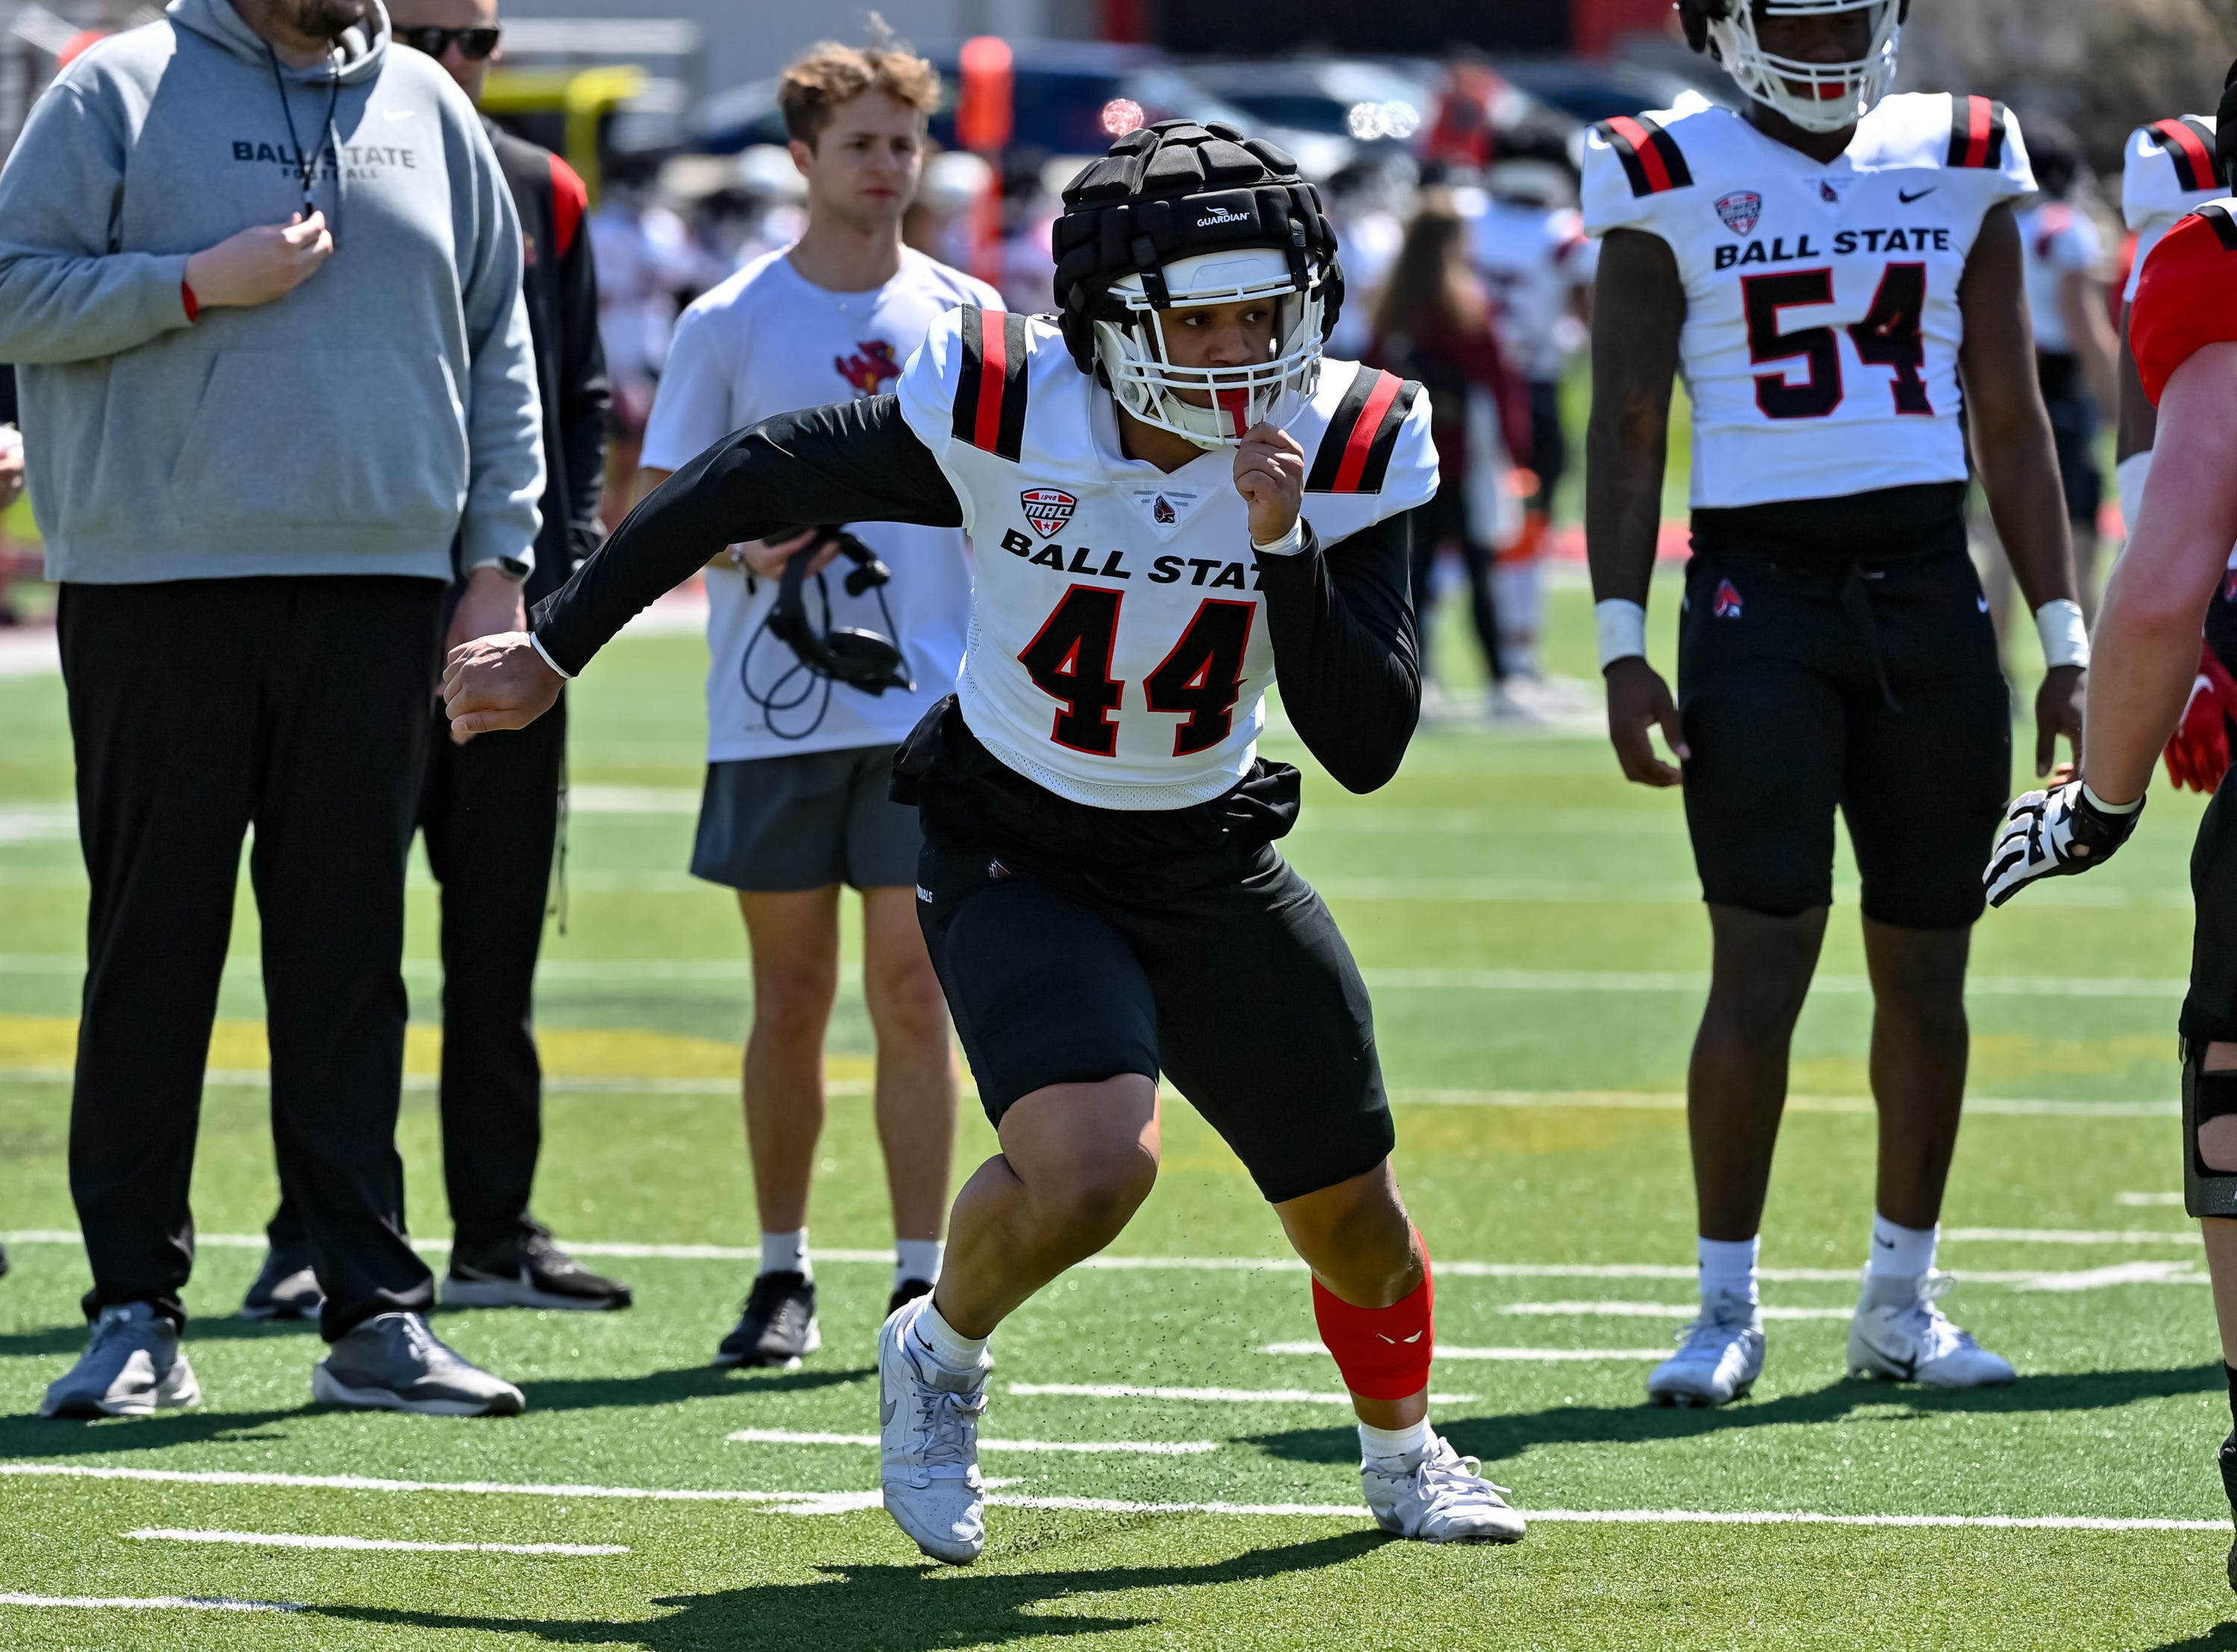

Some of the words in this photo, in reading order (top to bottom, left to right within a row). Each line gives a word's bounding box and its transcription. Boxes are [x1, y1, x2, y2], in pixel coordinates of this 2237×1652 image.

[233, 142, 303, 165] BAL
[1715, 234, 1819, 270] BALL
[1834, 228, 1949, 253] STATE
[1740, 262, 1934, 419] 54
[1025, 503, 1072, 519] MAC
[1000, 528, 1131, 579] BALL
[1016, 583, 1257, 757] 44
